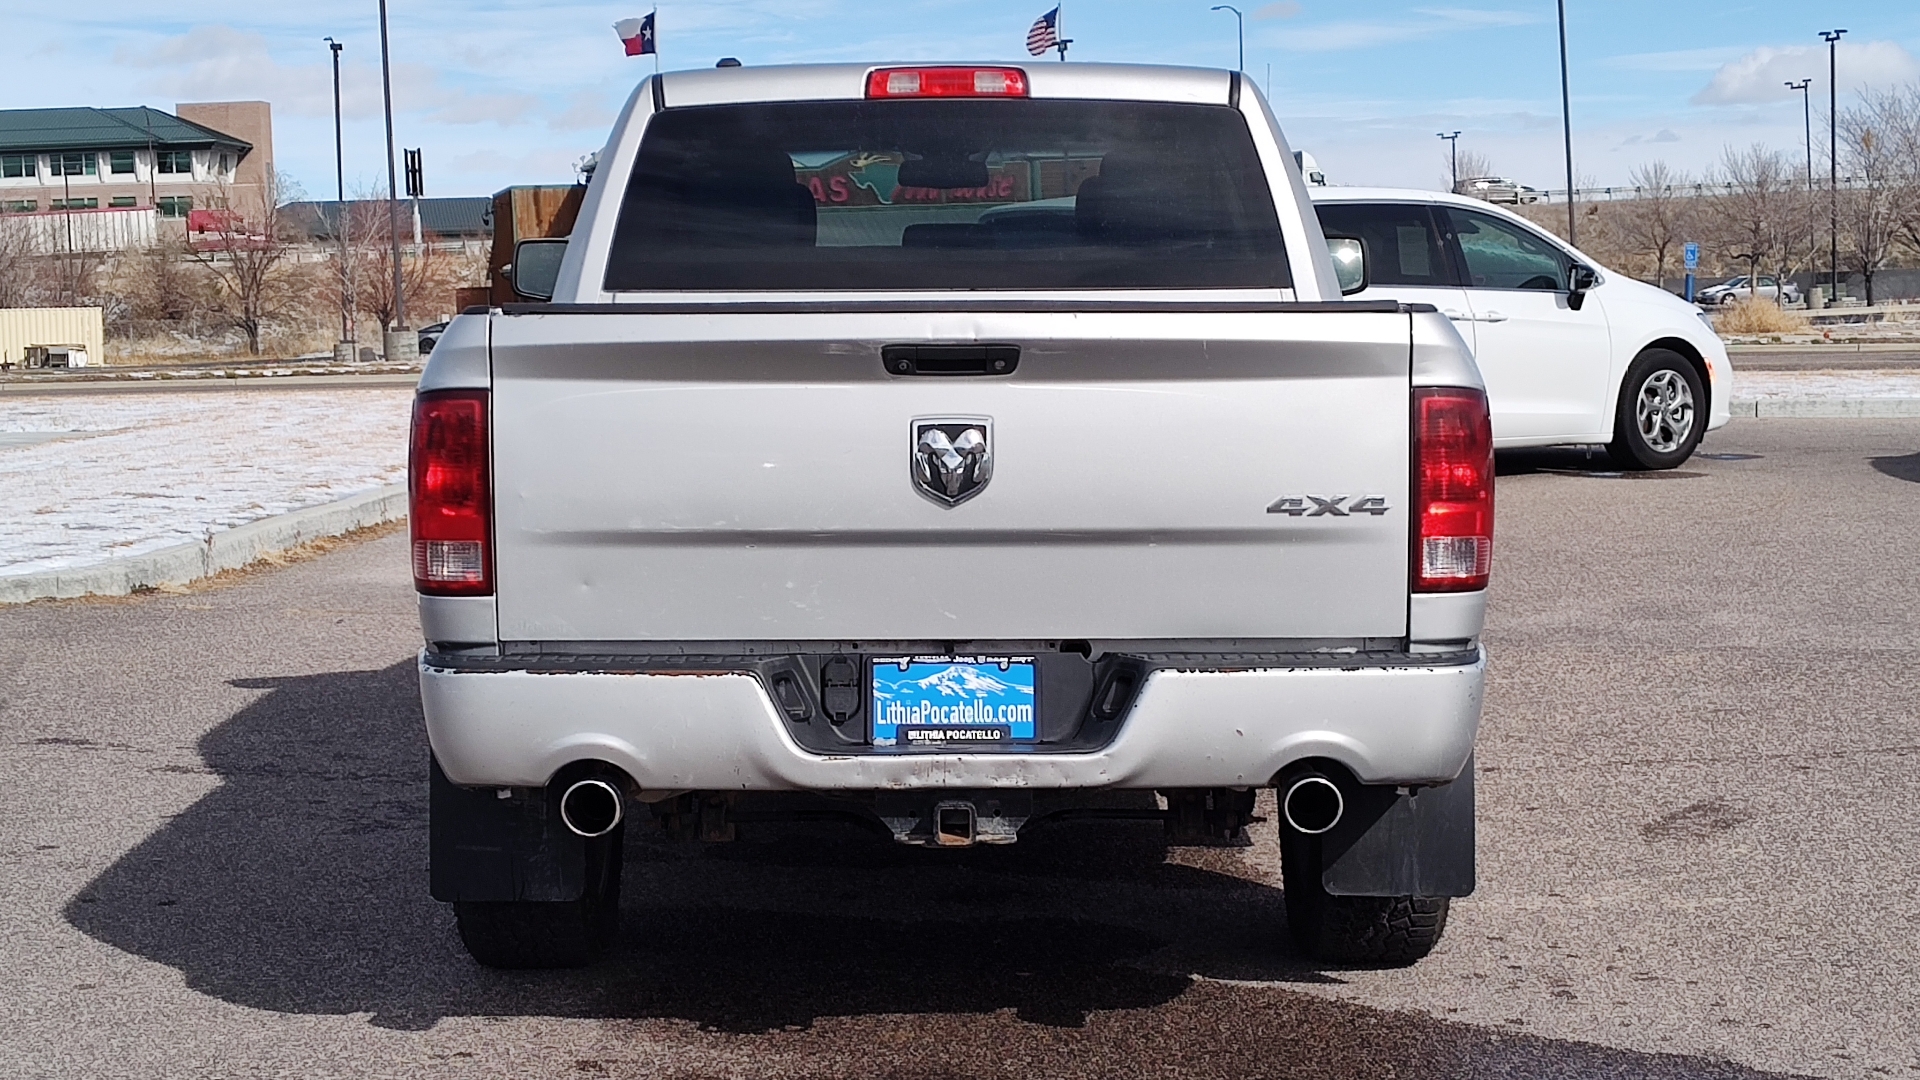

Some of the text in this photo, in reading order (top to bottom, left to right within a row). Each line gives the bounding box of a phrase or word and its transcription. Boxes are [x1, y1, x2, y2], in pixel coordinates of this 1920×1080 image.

[1265, 494, 1394, 517] 4X4
[876, 699, 1033, 725] LithiaPocatello.com
[946, 730, 1001, 740] POCATELLO
